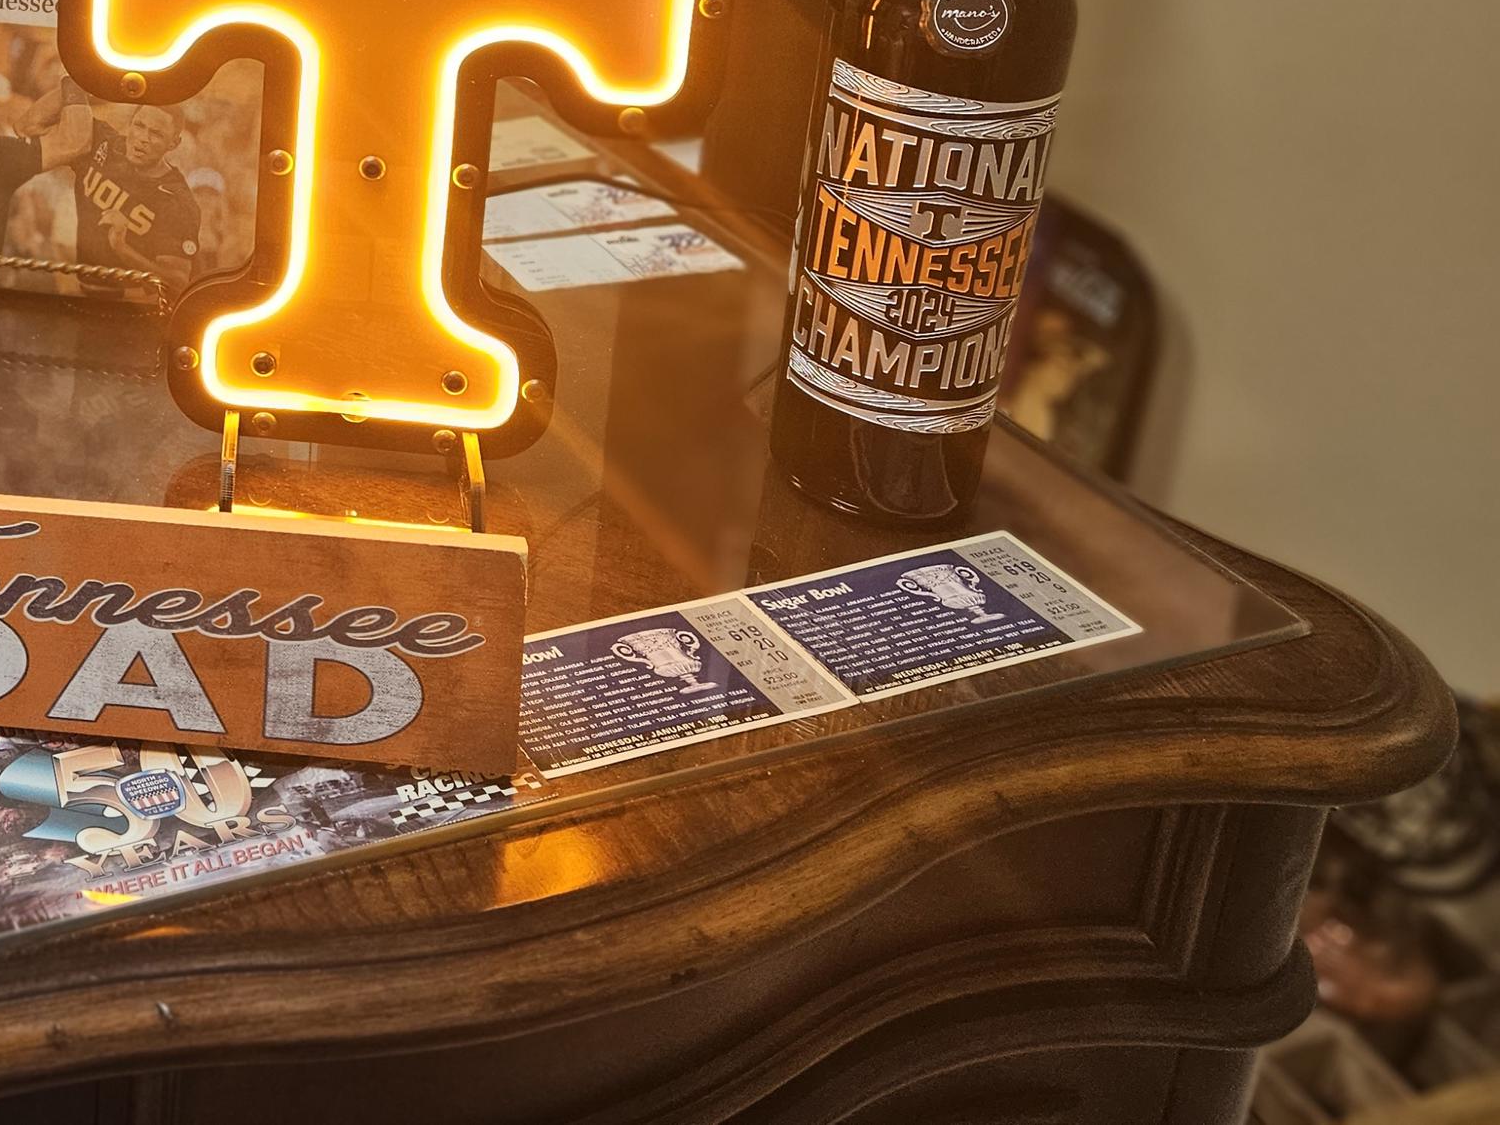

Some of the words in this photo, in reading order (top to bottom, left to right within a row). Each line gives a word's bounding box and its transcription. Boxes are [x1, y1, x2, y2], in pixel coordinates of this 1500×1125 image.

[944, 29, 998, 46] HANDCRAFTED
[817, 104, 1054, 203] NATIONAL
[83, 166, 155, 235] VOLS
[917, 201, 962, 240] T
[813, 190, 1036, 298] TENNESSEE
[885, 289, 956, 333] 2024
[1003, 560, 1037, 576] 619
[1029, 571, 1052, 584] 20
[760, 593, 810, 610] Sugar
[807, 582, 853, 600] Bowl
[1052, 582, 1067, 594] 9
[728, 625, 762, 642] 619
[753, 637, 776, 651] 20
[766, 649, 789, 663] 10
[892, 660, 950, 680] WEDNESDAY,
[953, 649, 994, 664] JANUARY
[582, 733, 649, 754] WEDNESDAY,
[650, 722, 695, 738] JANUARY
[124, 777, 170, 792] WILKESBORO
[129, 783, 169, 797] SPEEDWAY
[130, 775, 156, 786] NORTH
[52, 741, 252, 854] 50
[63, 803, 297, 883] YEARS
[171, 862, 189, 882] IT
[193, 855, 232, 878] ALL
[233, 833, 305, 866] BEGAN
